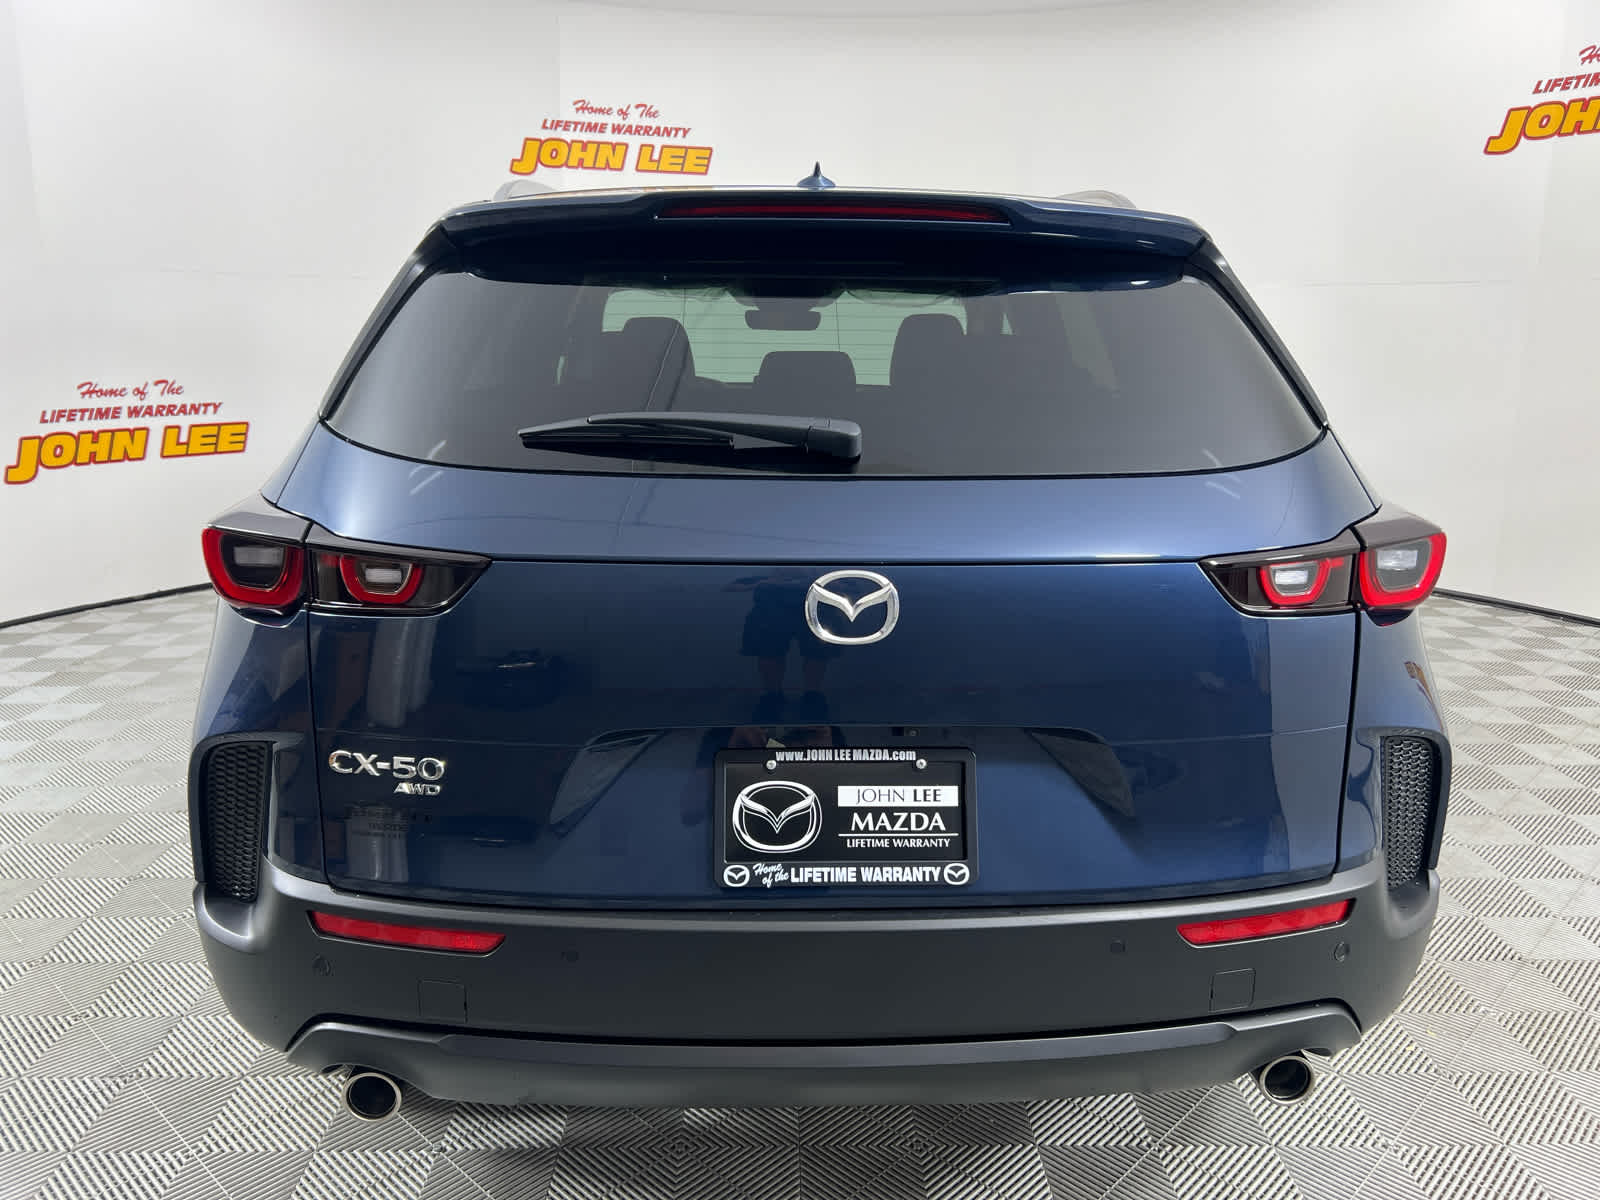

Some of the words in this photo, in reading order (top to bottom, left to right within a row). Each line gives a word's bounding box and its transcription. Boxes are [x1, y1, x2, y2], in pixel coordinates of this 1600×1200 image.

[572, 99, 614, 116] Home
[616, 105, 631, 120] of
[634, 104, 661, 119] The
[541, 119, 608, 134] LIFETIME
[611, 123, 691, 139] WARRANTY
[1484, 95, 1600, 155] JOH
[510, 137, 629, 175] JOHN
[635, 143, 713, 175] LEE
[77, 381, 129, 399] Home
[132, 382, 149, 400] of
[153, 379, 185, 396] The
[39, 406, 122, 424] LIFETIME
[127, 402, 223, 419] WARRANTY
[4, 427, 150, 485] JOHN
[160, 421, 249, 458] LEE
[834, 749, 851, 761] LEE
[328, 750, 446, 781] CX-50
[393, 782, 442, 796] AWD
[856, 788, 905, 805] JOHN
[913, 788, 942, 803] LEE
[851, 812, 946, 831] MAZDA
[847, 838, 890, 848] LIFETIME
[893, 838, 951, 848] WARRANTY
[753, 864, 782, 876] Home
[761, 876, 776, 889] of
[774, 870, 789, 881] the
[790, 867, 857, 883] LIFETIME
[860, 866, 941, 883] WARRANTY
